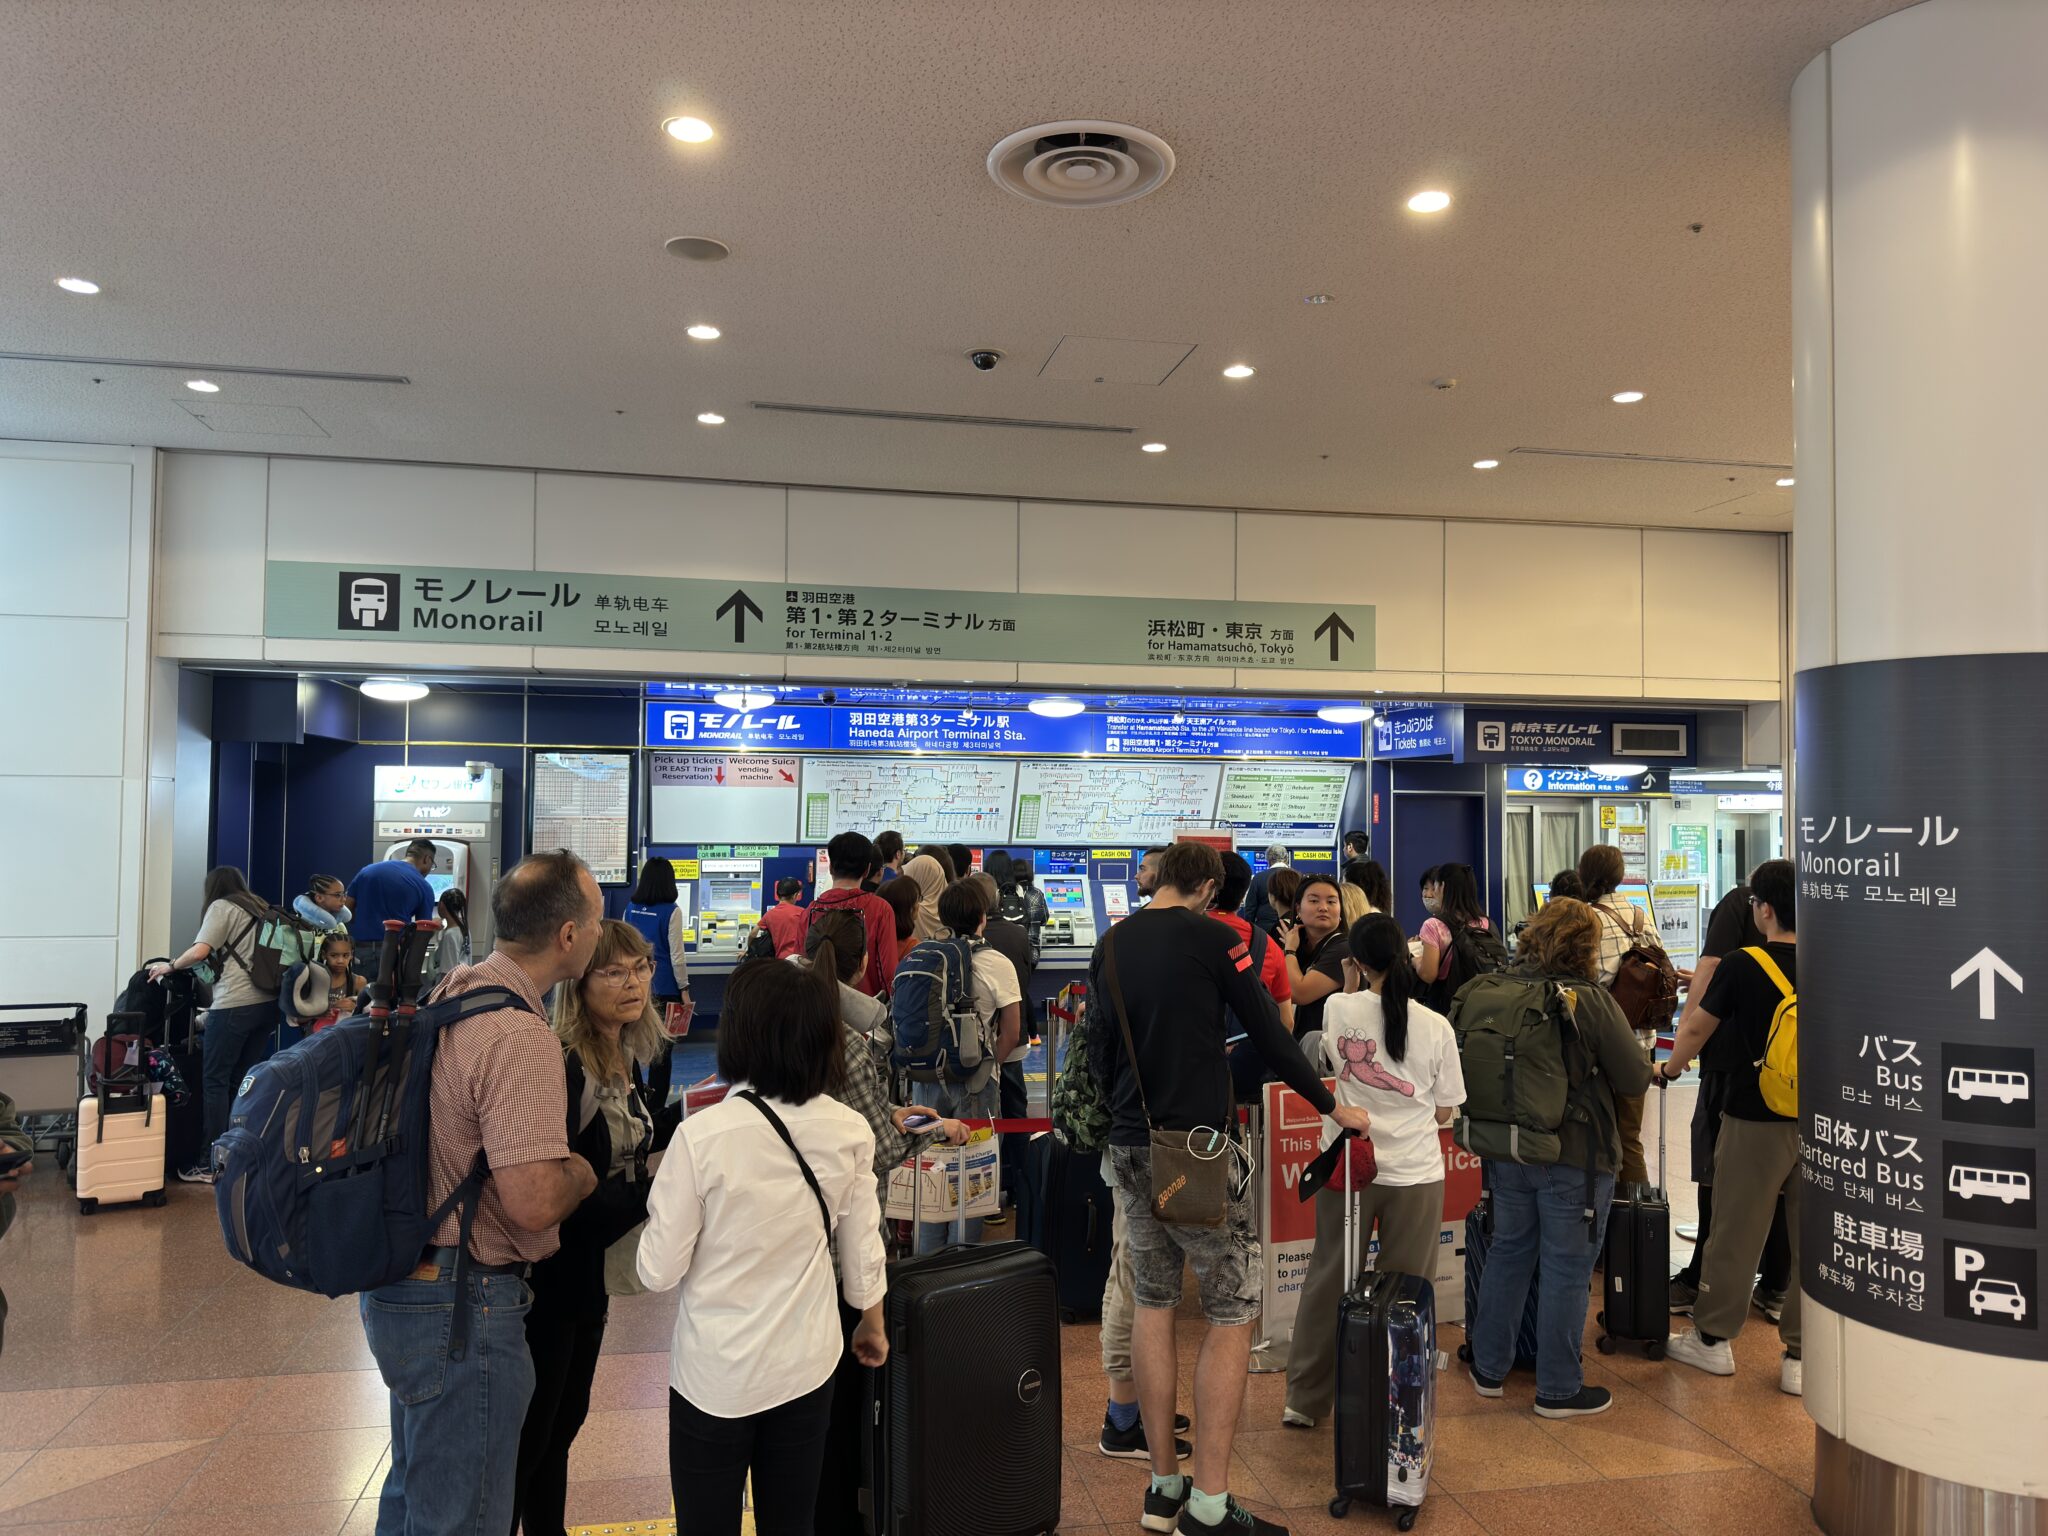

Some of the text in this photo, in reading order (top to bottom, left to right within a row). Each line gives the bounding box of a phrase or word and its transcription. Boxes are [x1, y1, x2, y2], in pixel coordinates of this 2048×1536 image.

[414, 577, 581, 607] モノレール
[801, 591, 856, 605] 羽田空港
[594, 594, 670, 612] 单轨电车
[413, 607, 543, 632] Monorail
[593, 620, 668, 637] 모노레일
[785, 627, 805, 638] for
[810, 628, 866, 641] Terminal
[1147, 619, 1295, 641] 浜松町・東京 方面
[1147, 639, 1165, 650] for
[698, 713, 801, 730] モノレール
[849, 712, 1010, 729] 羽田空港第3ターミナル駅
[1394, 715, 1434, 735] きっぷうりば
[1510, 722, 1602, 735] 東京モノレール
[698, 731, 743, 740] MONORAIL
[849, 727, 1026, 741] Haneda Airport Terminal 3 Sta.
[1510, 735, 1596, 746] TOKYO MONORAIL
[1394, 737, 1417, 750] Tickets
[654, 756, 724, 766] Pick up tickets
[654, 765, 668, 773] (JR
[729, 757, 796, 766] Welcome Suica
[662, 773, 713, 781] Reservation)
[737, 766, 769, 774] vending
[1547, 781, 1596, 791] Information
[413, 806, 446, 818] ATM
[1801, 815, 1960, 847] モノレール
[1801, 851, 1900, 877] Monorail
[1801, 881, 1850, 901] 单轨电车
[1863, 885, 1957, 907] 모노레일
[1858, 1034, 1922, 1067] バス
[1876, 1065, 1923, 1092] Bus
[1841, 1085, 1872, 1105] 巴士
[1884, 1093, 1923, 1113] 버스
[1280, 1136, 1312, 1153] This
[1814, 1113, 1924, 1164] 団体バス
[1876, 1162, 1925, 1192] Bus
[1843, 1180, 1925, 1213] 단체 버스
[1833, 1210, 1925, 1262] 駐車場
[1277, 1252, 1312, 1264] Please
[1954, 1246, 1985, 1282] P
[1277, 1269, 1288, 1279] to
[1833, 1243, 1925, 1293] Parking
[1818, 1263, 1856, 1293] 停车场
[1867, 1282, 1925, 1312] 주차장
